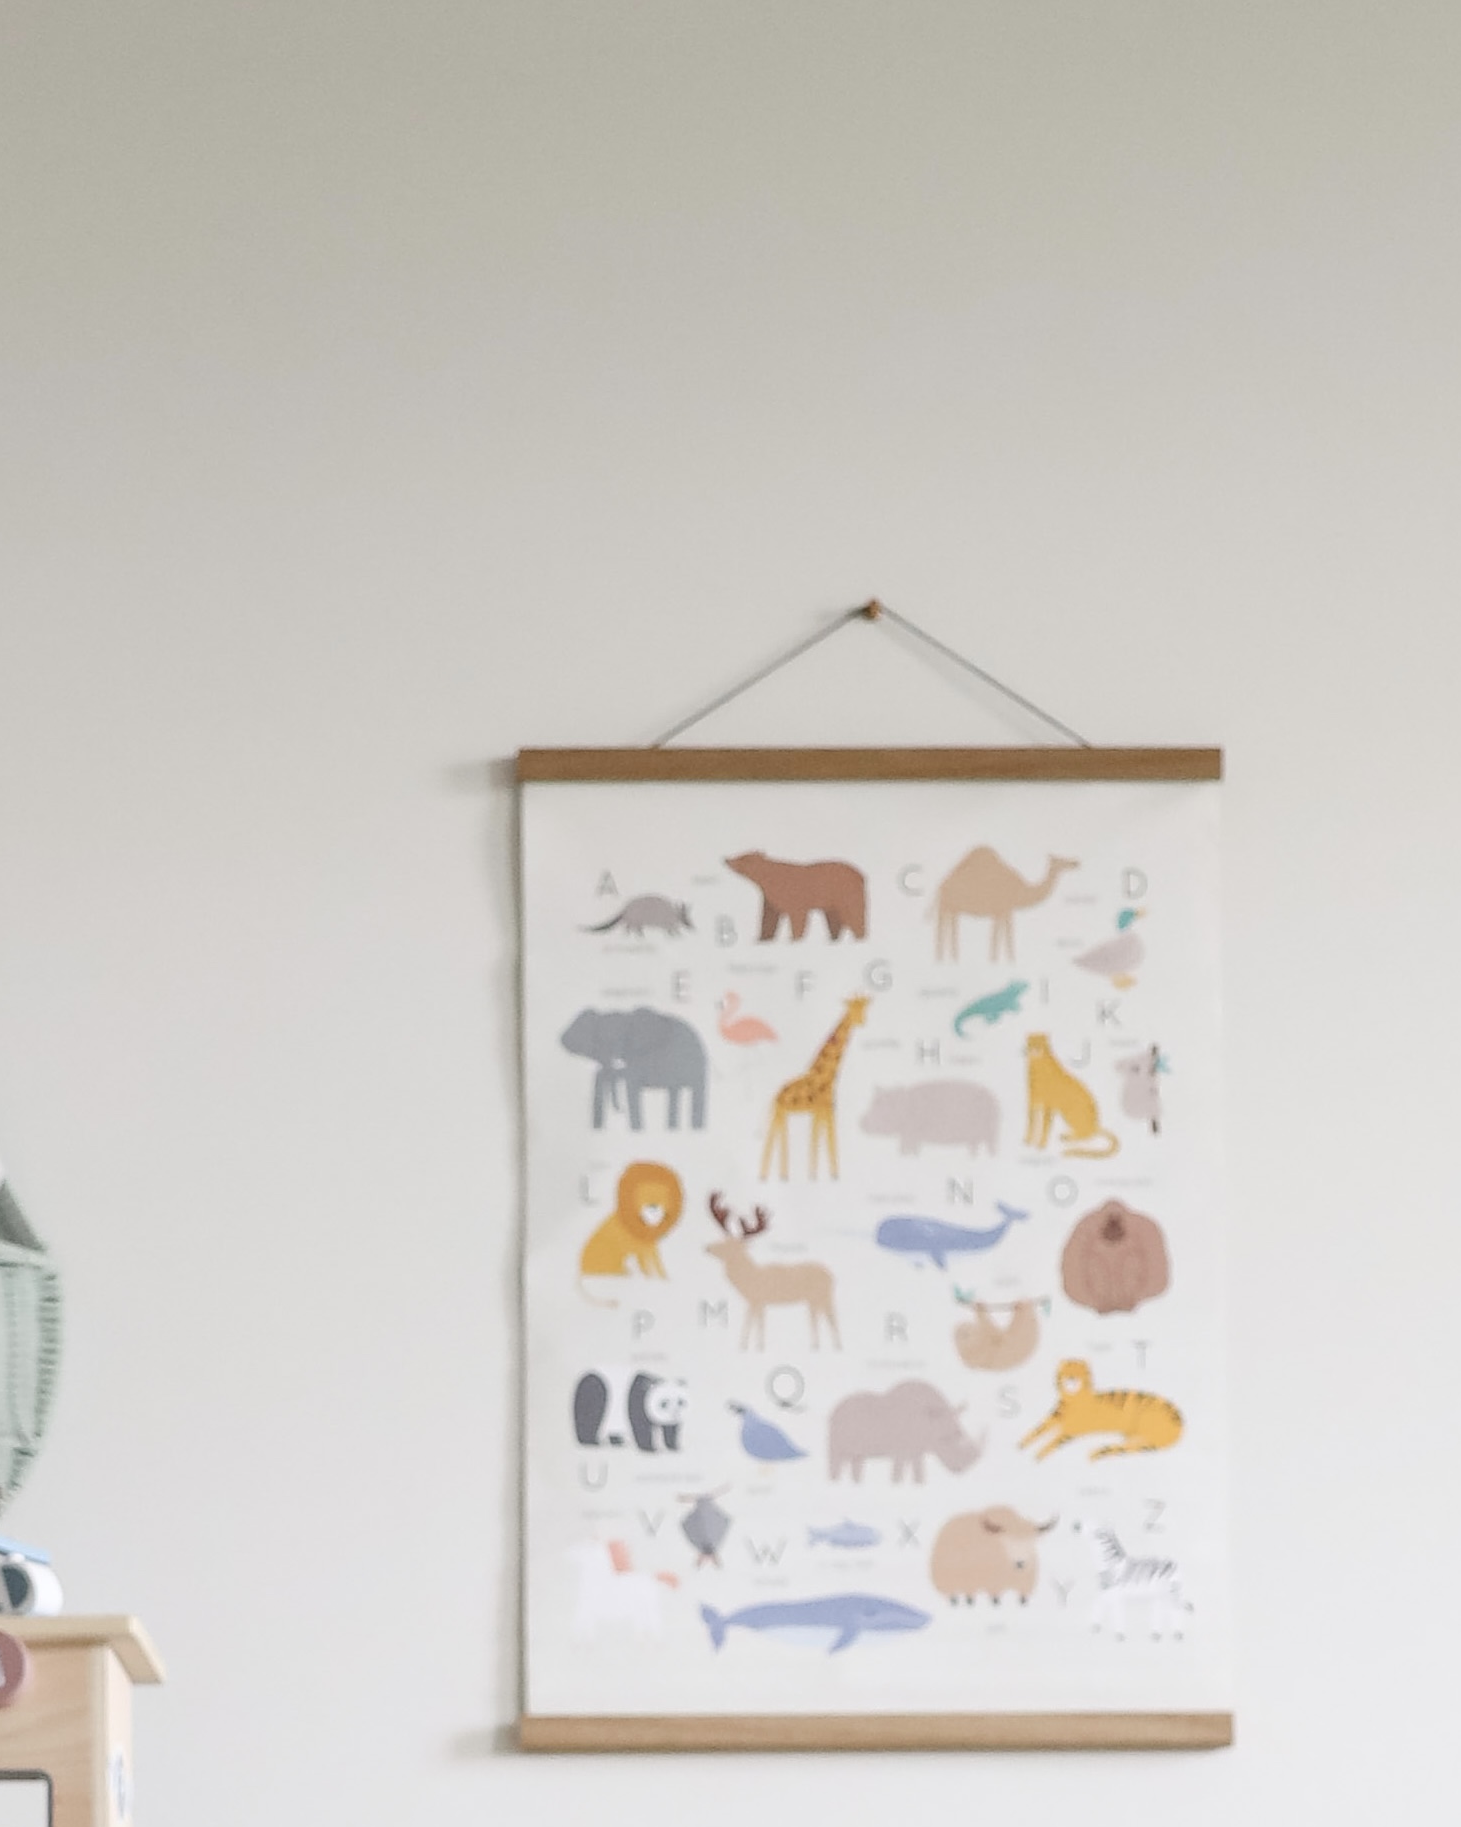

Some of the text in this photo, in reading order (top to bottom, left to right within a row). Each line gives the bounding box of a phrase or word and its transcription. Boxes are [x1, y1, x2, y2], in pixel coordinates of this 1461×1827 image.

[596, 870, 619, 896] A
[896, 863, 923, 897] C
[1122, 867, 1148, 900] D
[715, 914, 737, 947] B
[671, 971, 691, 1003] E
[794, 969, 815, 1001] F
[863, 959, 893, 993] G
[1097, 1001, 1121, 1027] K
[916, 1040, 940, 1065] H
[947, 1178, 973, 1205] N
[1046, 1175, 1079, 1208] O
[632, 1310, 655, 1339] P
[699, 1299, 728, 1326] M
[884, 1312, 907, 1341] R
[1131, 1338, 1151, 1369] T
[766, 1366, 804, 1412] Q
[997, 1384, 1021, 1419] S
[578, 1462, 607, 1493] U
[638, 1510, 664, 1537] V
[1143, 1500, 1166, 1533] Z
[898, 1520, 920, 1549] X
[746, 1539, 786, 1565] W
